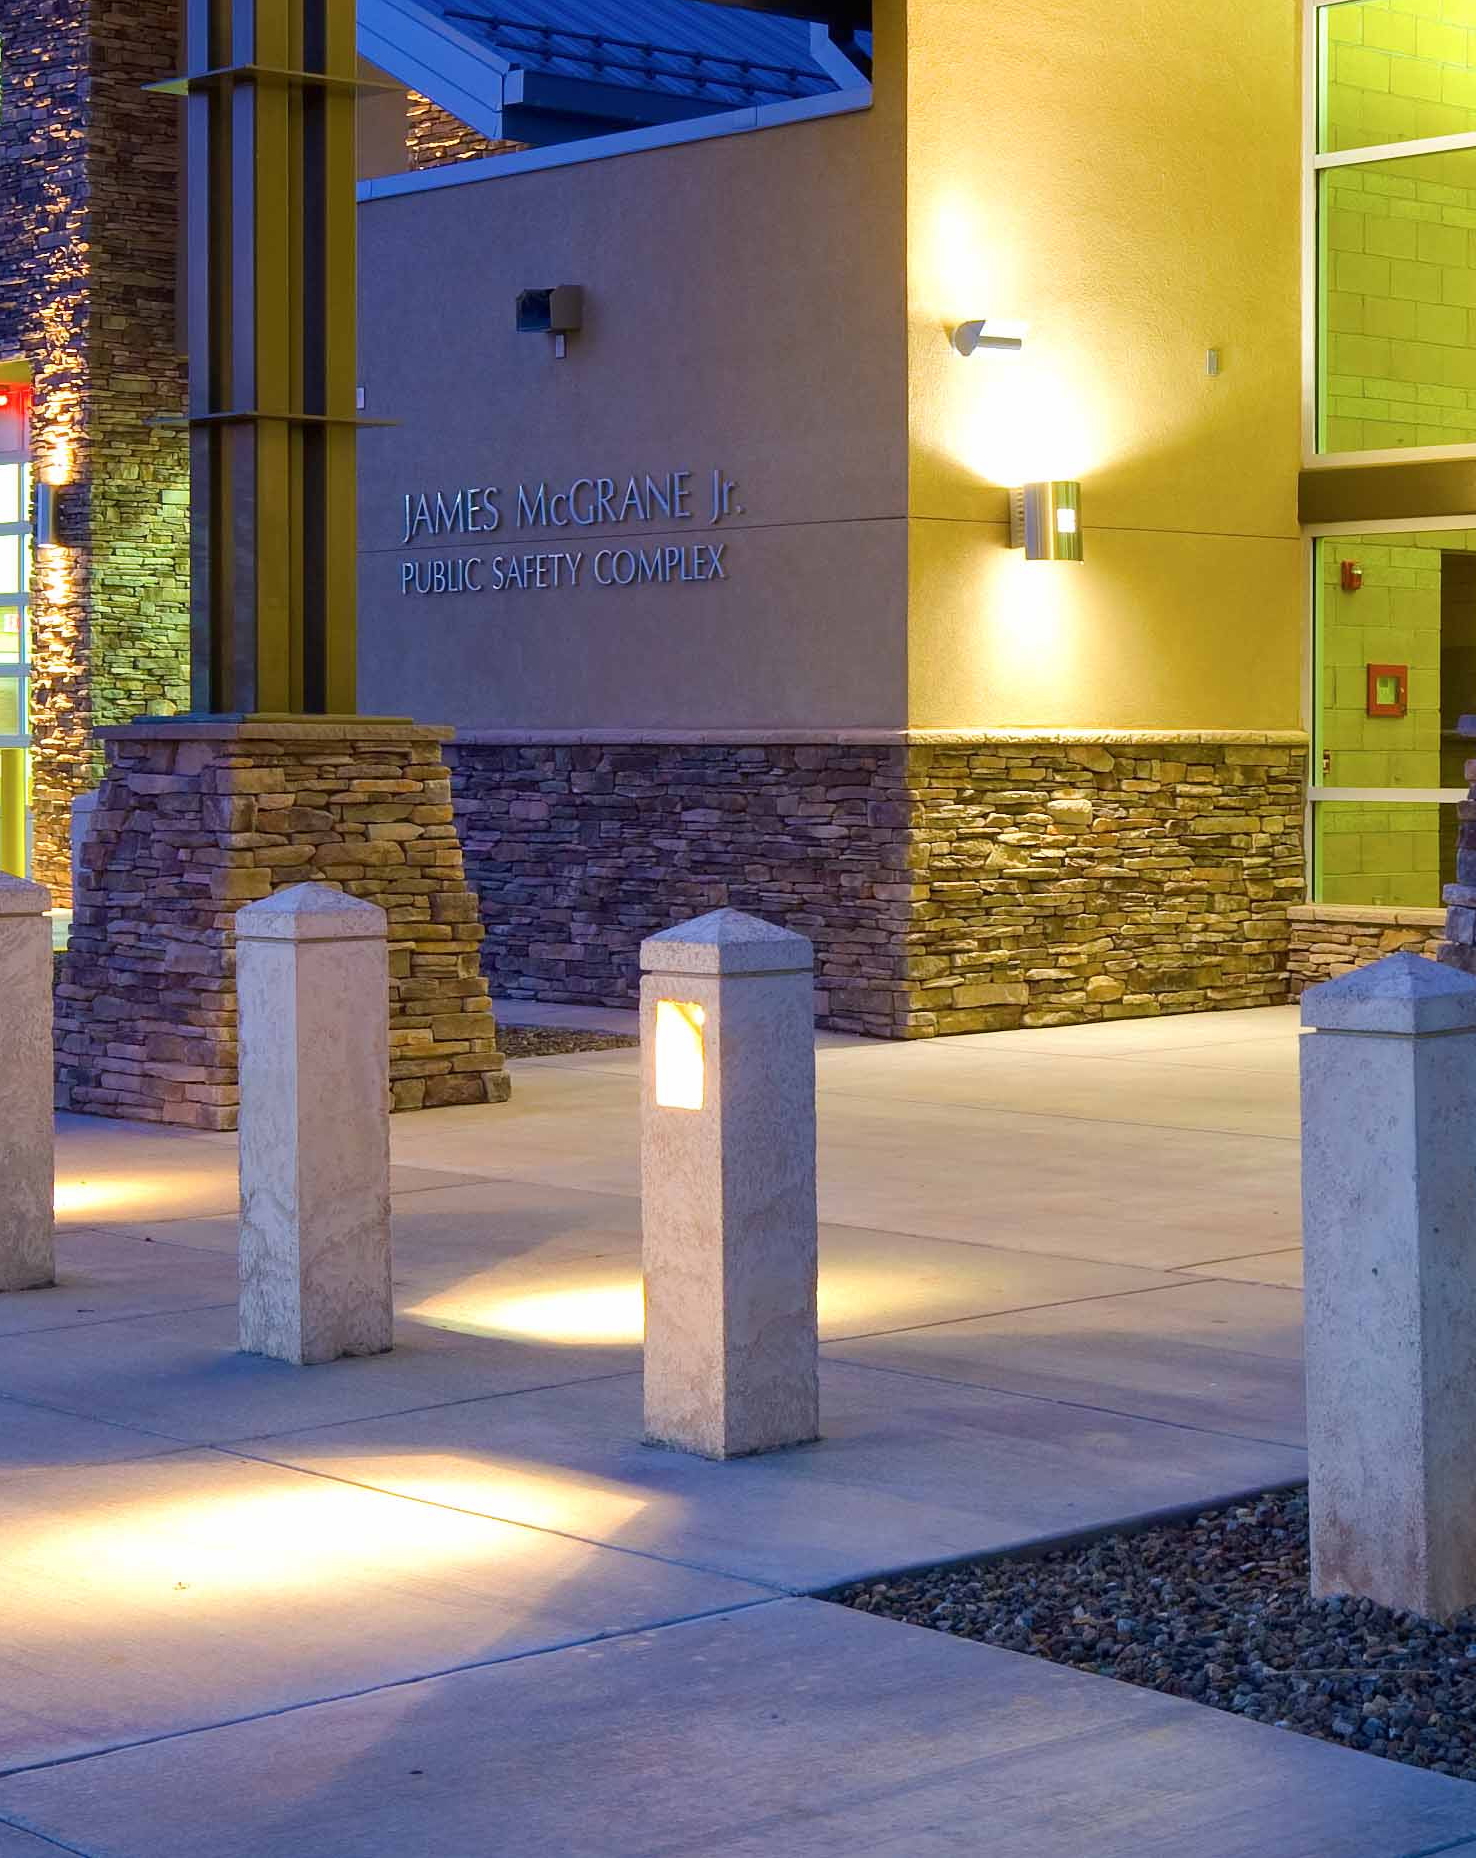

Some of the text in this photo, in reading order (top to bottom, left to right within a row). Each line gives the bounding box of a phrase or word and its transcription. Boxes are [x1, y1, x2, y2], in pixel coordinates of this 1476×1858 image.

[403, 468, 746, 543] JAMES McGRANE Jr.
[401, 543, 729, 595] PUBLIC SAFETY COMPLEX
